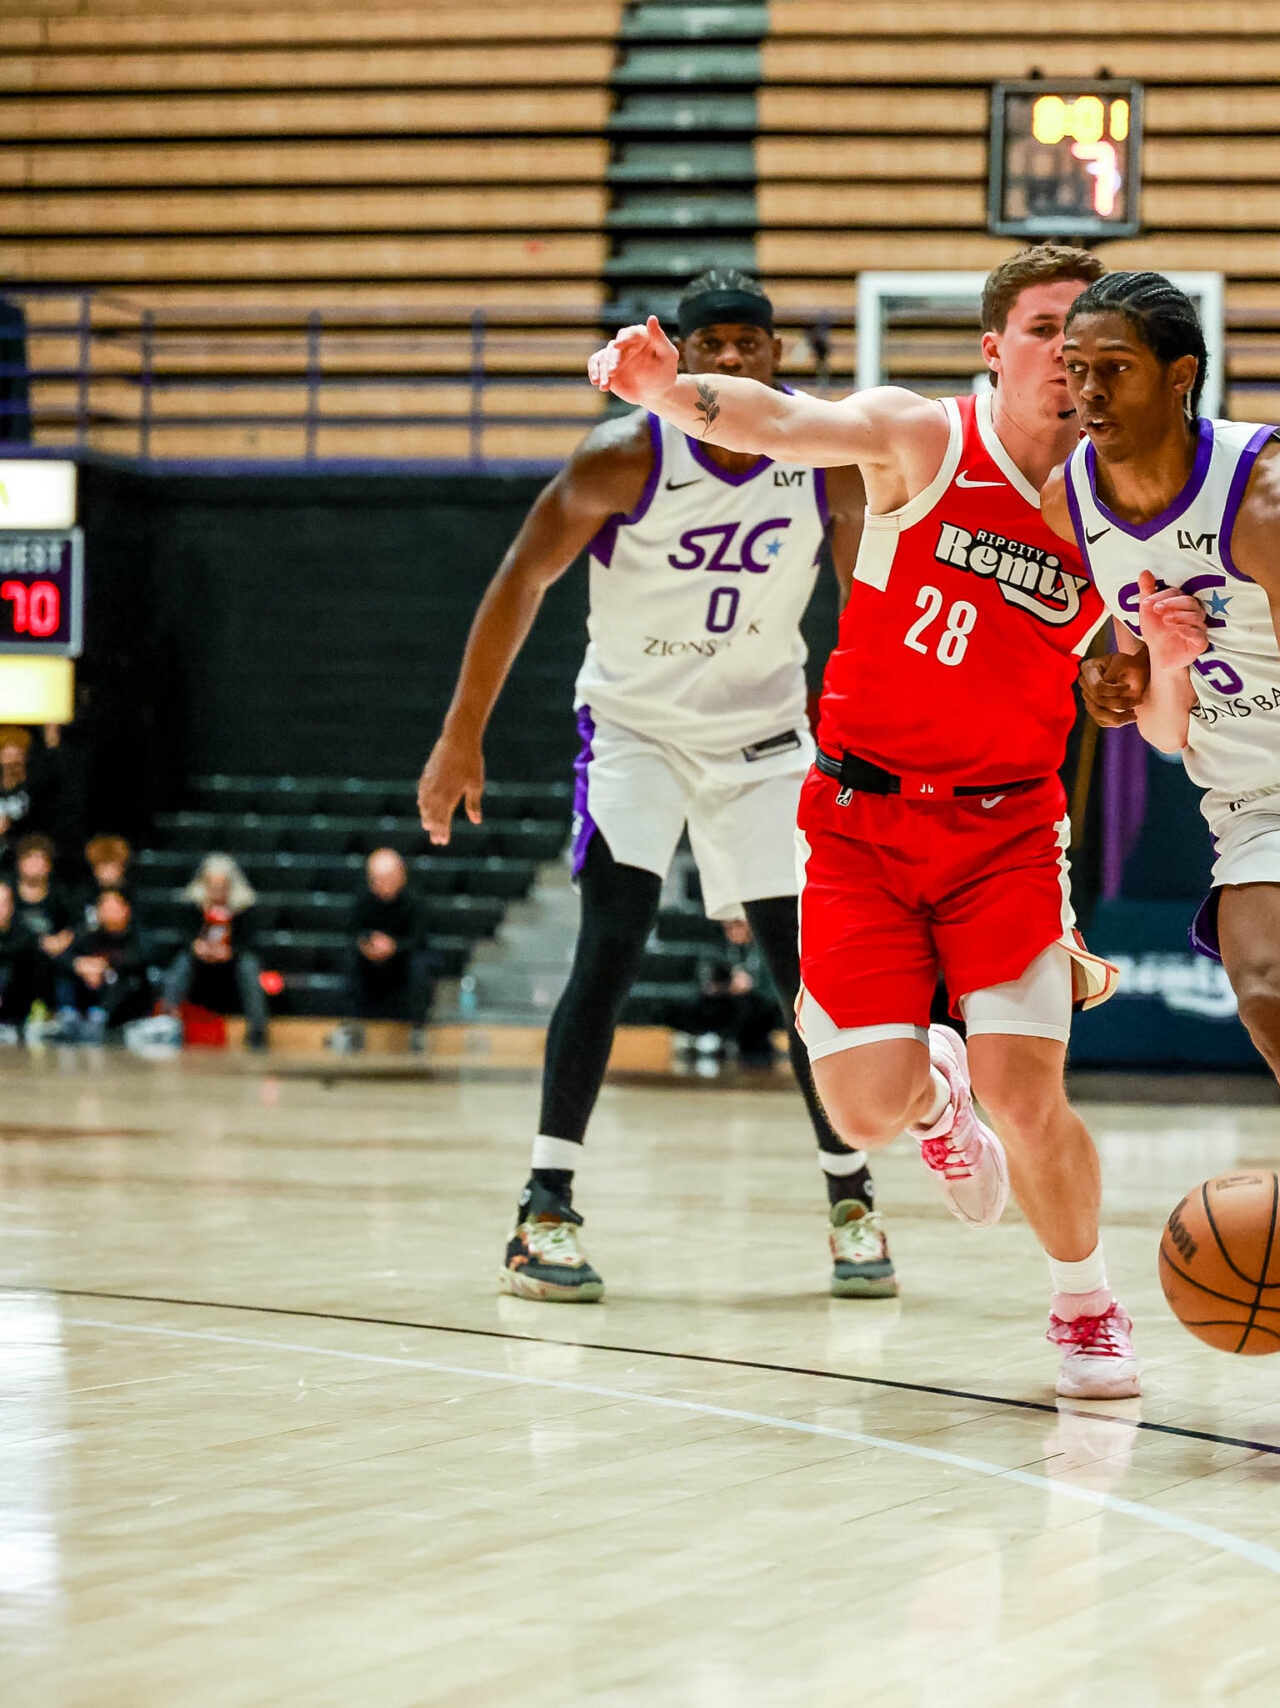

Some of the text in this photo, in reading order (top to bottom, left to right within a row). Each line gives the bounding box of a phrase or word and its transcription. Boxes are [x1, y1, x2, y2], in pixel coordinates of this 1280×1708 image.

[1070, 140, 1117, 217] 7
[773, 471, 806, 487] LVT
[976, 530, 1045, 561] RIP CITY
[1177, 530, 1217, 555] LVT
[935, 522, 1090, 624] Remix
[1, 580, 60, 637] 70
[705, 586, 740, 634] 0
[903, 585, 978, 666] 28
[644, 636, 718, 657] ZIONS
